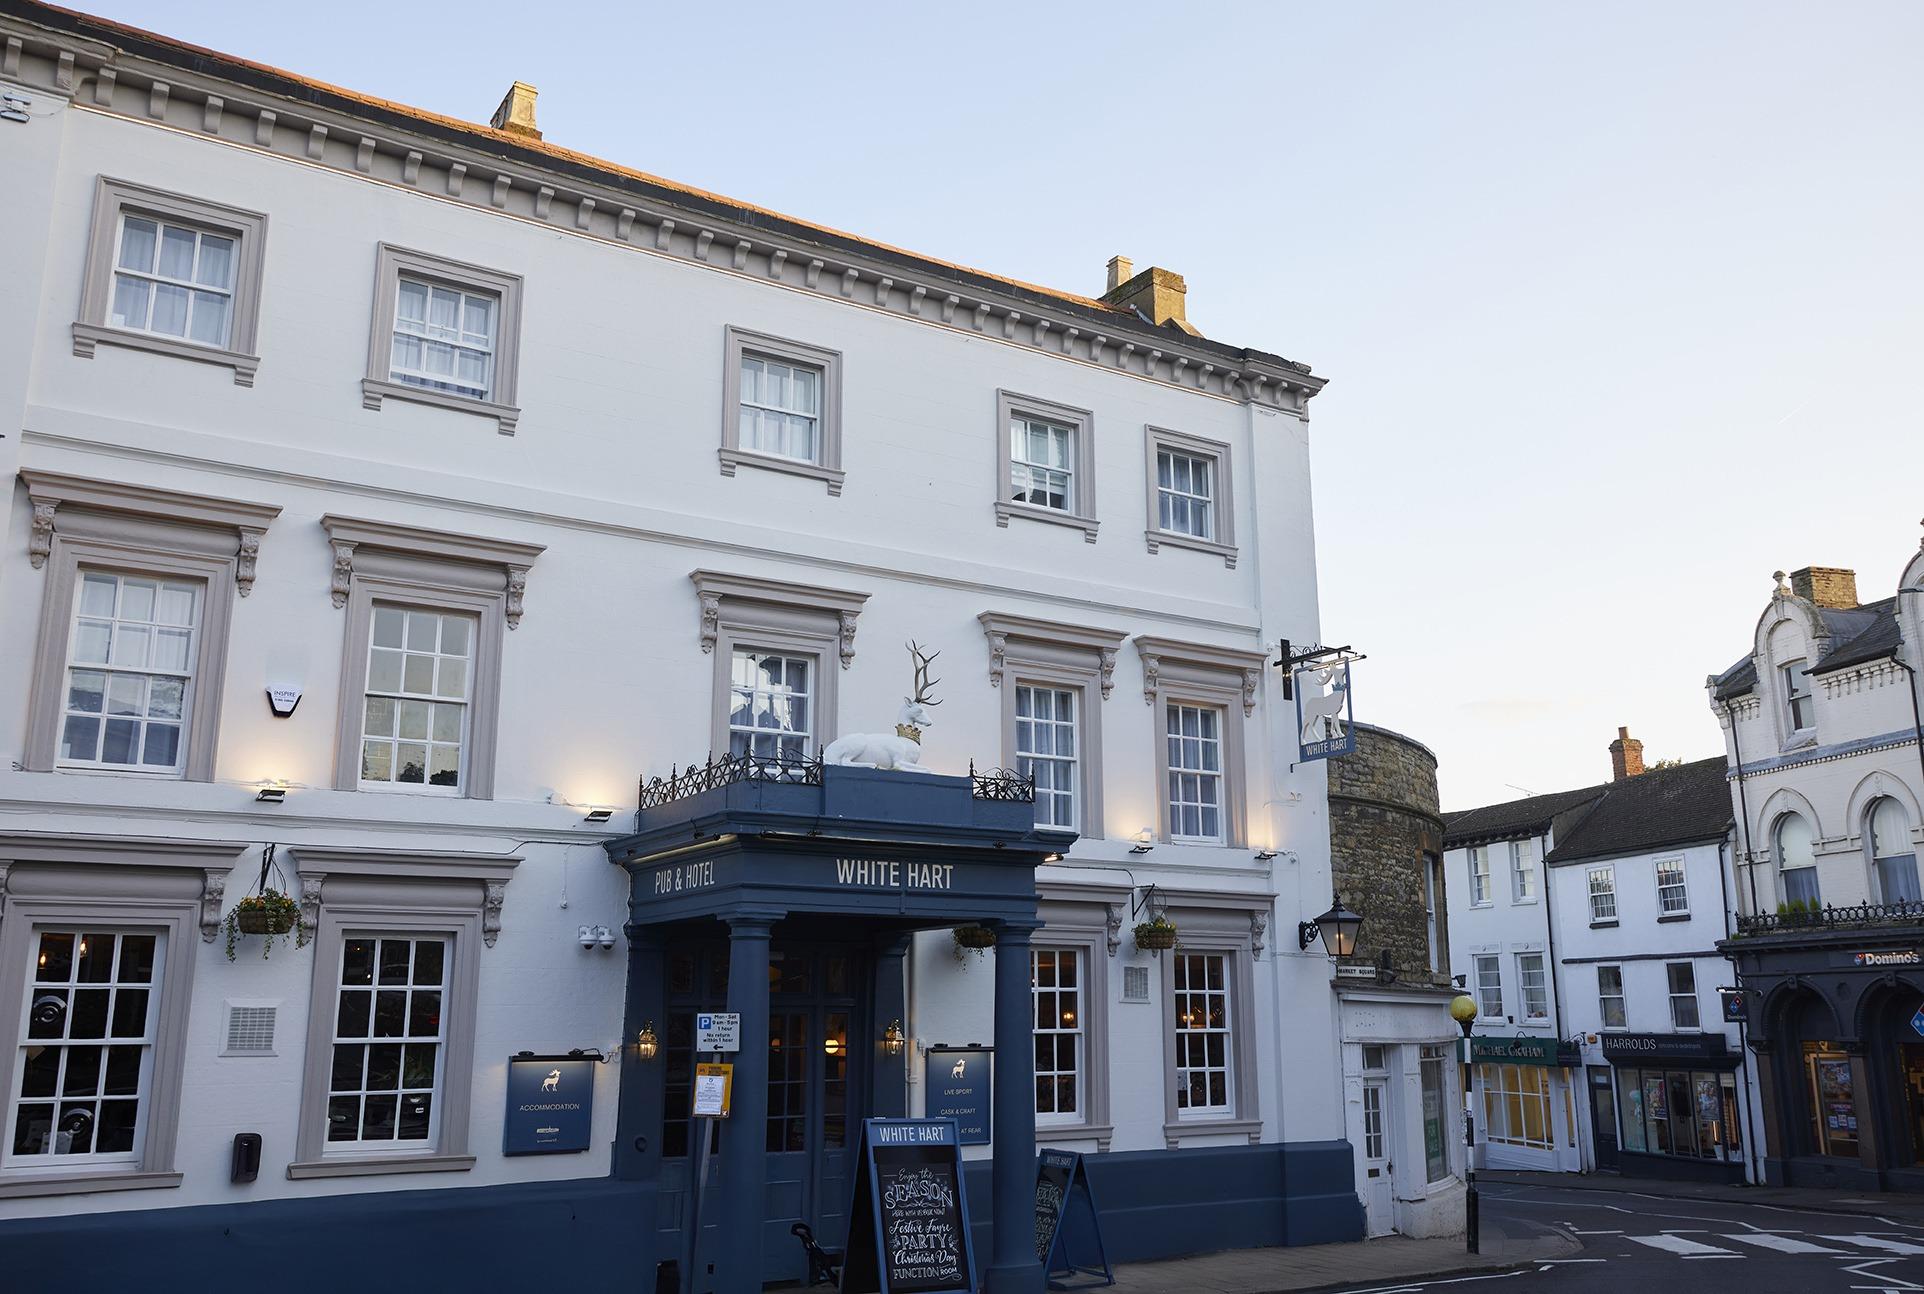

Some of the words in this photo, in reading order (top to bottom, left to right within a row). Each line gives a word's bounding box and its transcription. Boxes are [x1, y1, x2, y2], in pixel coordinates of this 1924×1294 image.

[273, 690, 296, 698] INSPIRE
[1306, 742, 1328, 756] WHITE
[1330, 738, 1347, 752] HART
[655, 869, 672, 894] PUB
[675, 867, 682, 891] &
[686, 860, 715, 889] HOTEL
[836, 858, 900, 887] WHITE
[907, 862, 954, 889] HART
[1865, 951, 1920, 966] Domino's
[701, 1017, 710, 1029] P
[1605, 1038, 1657, 1050] HARROLDS
[955, 1088, 973, 1096] SPORT
[519, 1103, 580, 1112] ACCOMMODATION
[880, 1127, 916, 1142] WHITE
[918, 1126, 944, 1142] HART
[898, 1168, 919, 1182] Enjoy
[919, 1167, 934, 1180] the
[884, 1180, 953, 1209] SEASON
[889, 1219, 924, 1235] Festive
[925, 1218, 953, 1234] Fayre
[900, 1233, 947, 1250] PARTY
[892, 1249, 935, 1265] Christmas
[935, 1249, 957, 1266] Day
[892, 1266, 939, 1280] FUNCTION
[940, 1266, 958, 1276] ROOM
